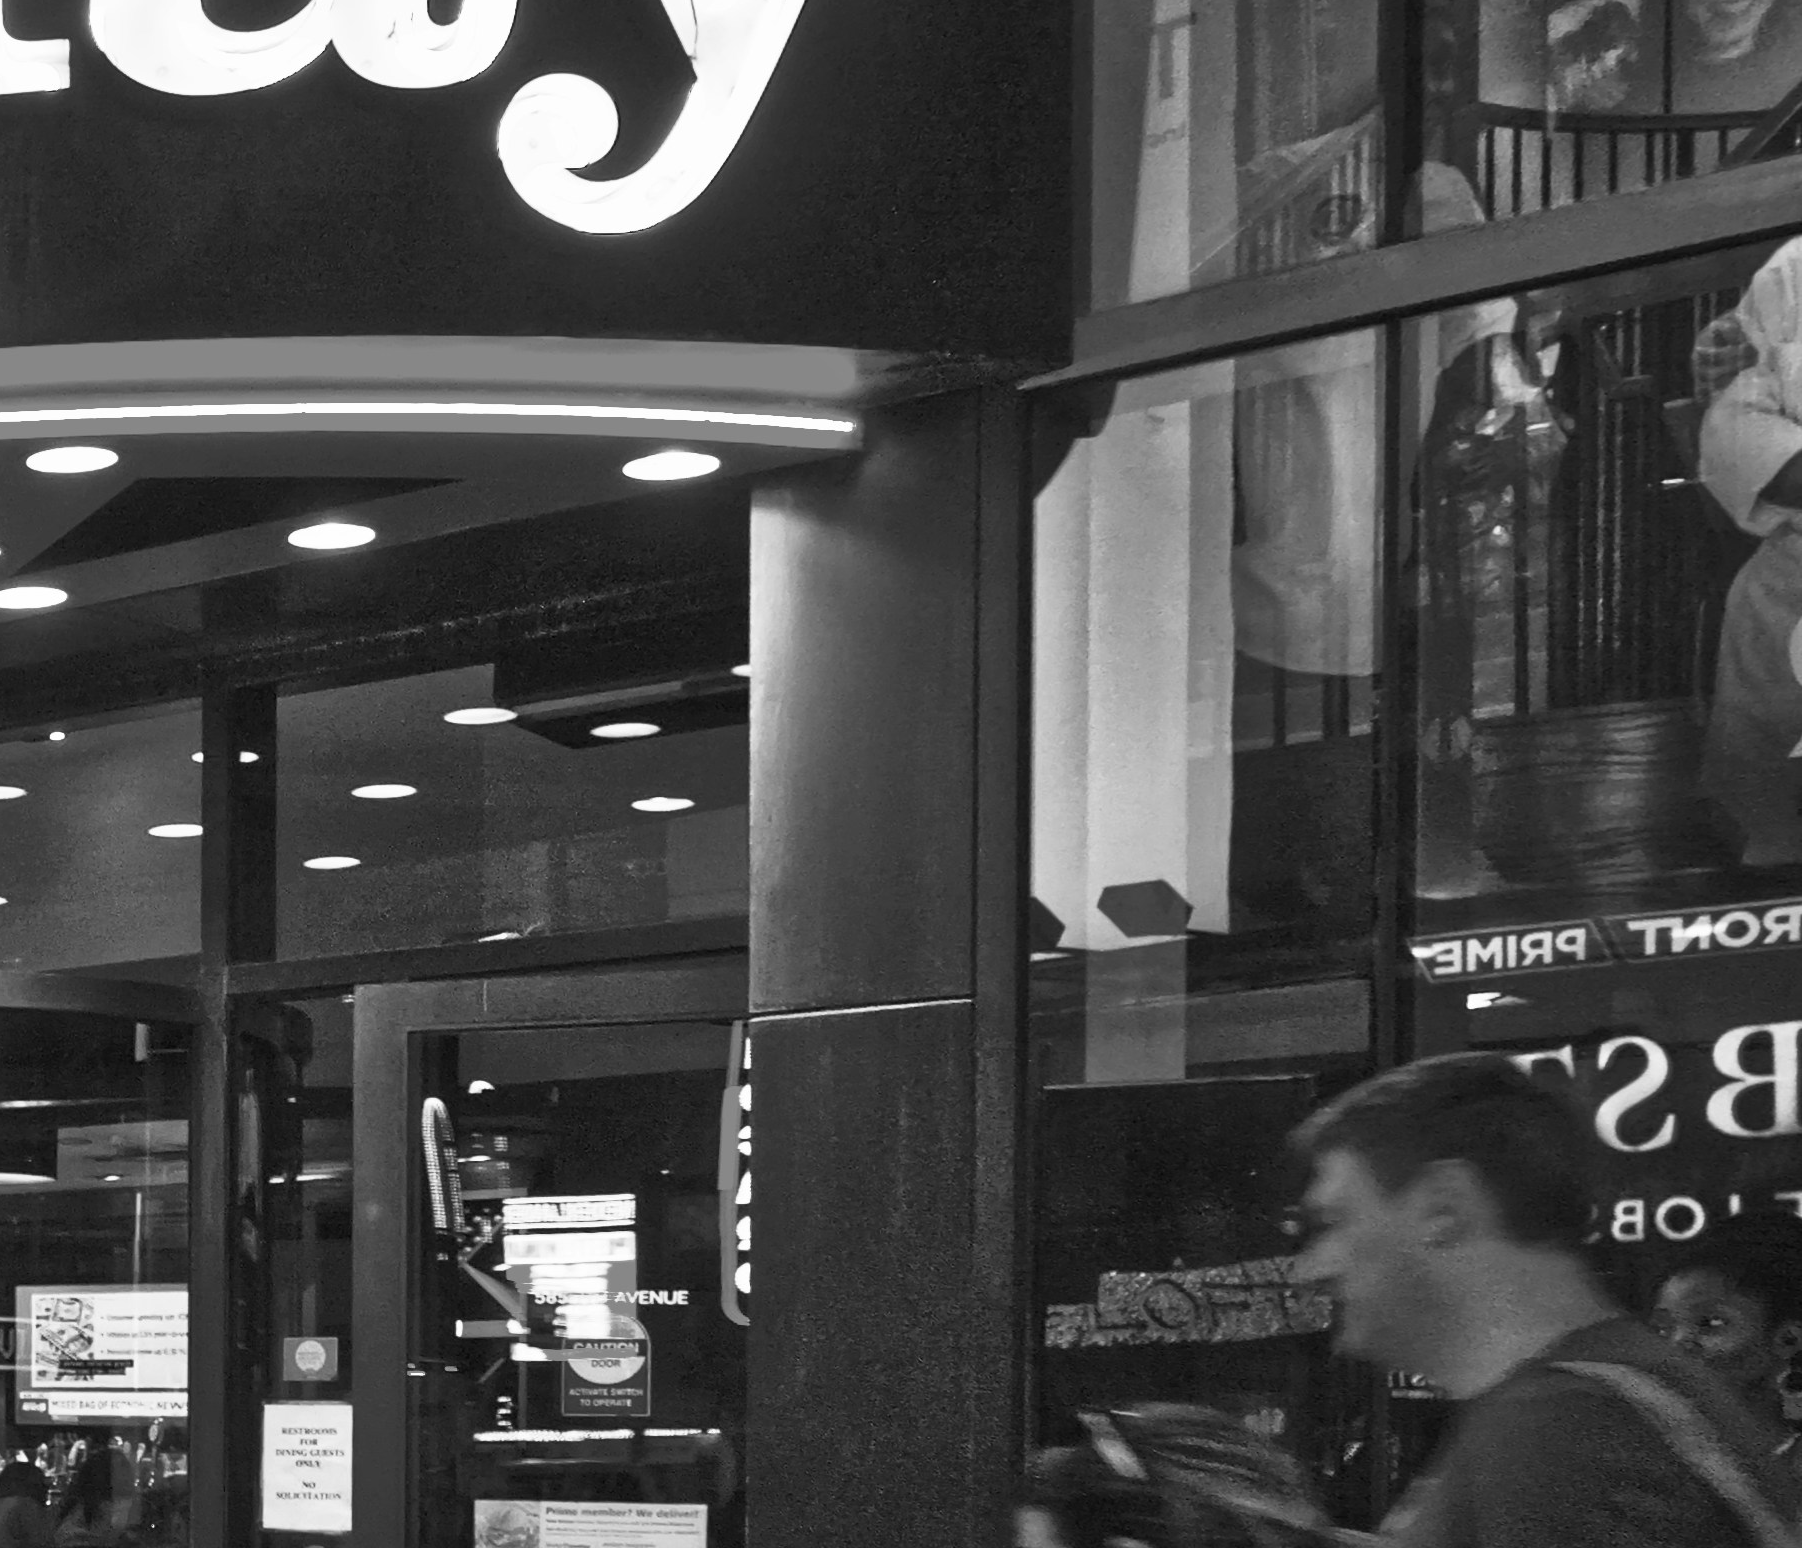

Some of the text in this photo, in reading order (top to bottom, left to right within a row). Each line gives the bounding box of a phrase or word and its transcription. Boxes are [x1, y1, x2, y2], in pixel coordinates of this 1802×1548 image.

[613, 1289, 690, 1305] AVENUE
[591, 1359, 621, 1368] DOOR
[610, 1388, 643, 1397] SWITCH
[580, 1399, 622, 1407] TO OPERATE
[281, 1427, 337, 1435] RESTROOMS
[300, 1438, 318, 1446] FOR
[309, 1449, 345, 1457] GUESTS
[295, 1460, 321, 1468] ONLY
[302, 1481, 316, 1489] NO
[546, 1507, 578, 1516] Prime
[581, 1507, 633, 1517] member?
[636, 1509, 653, 1517] We
